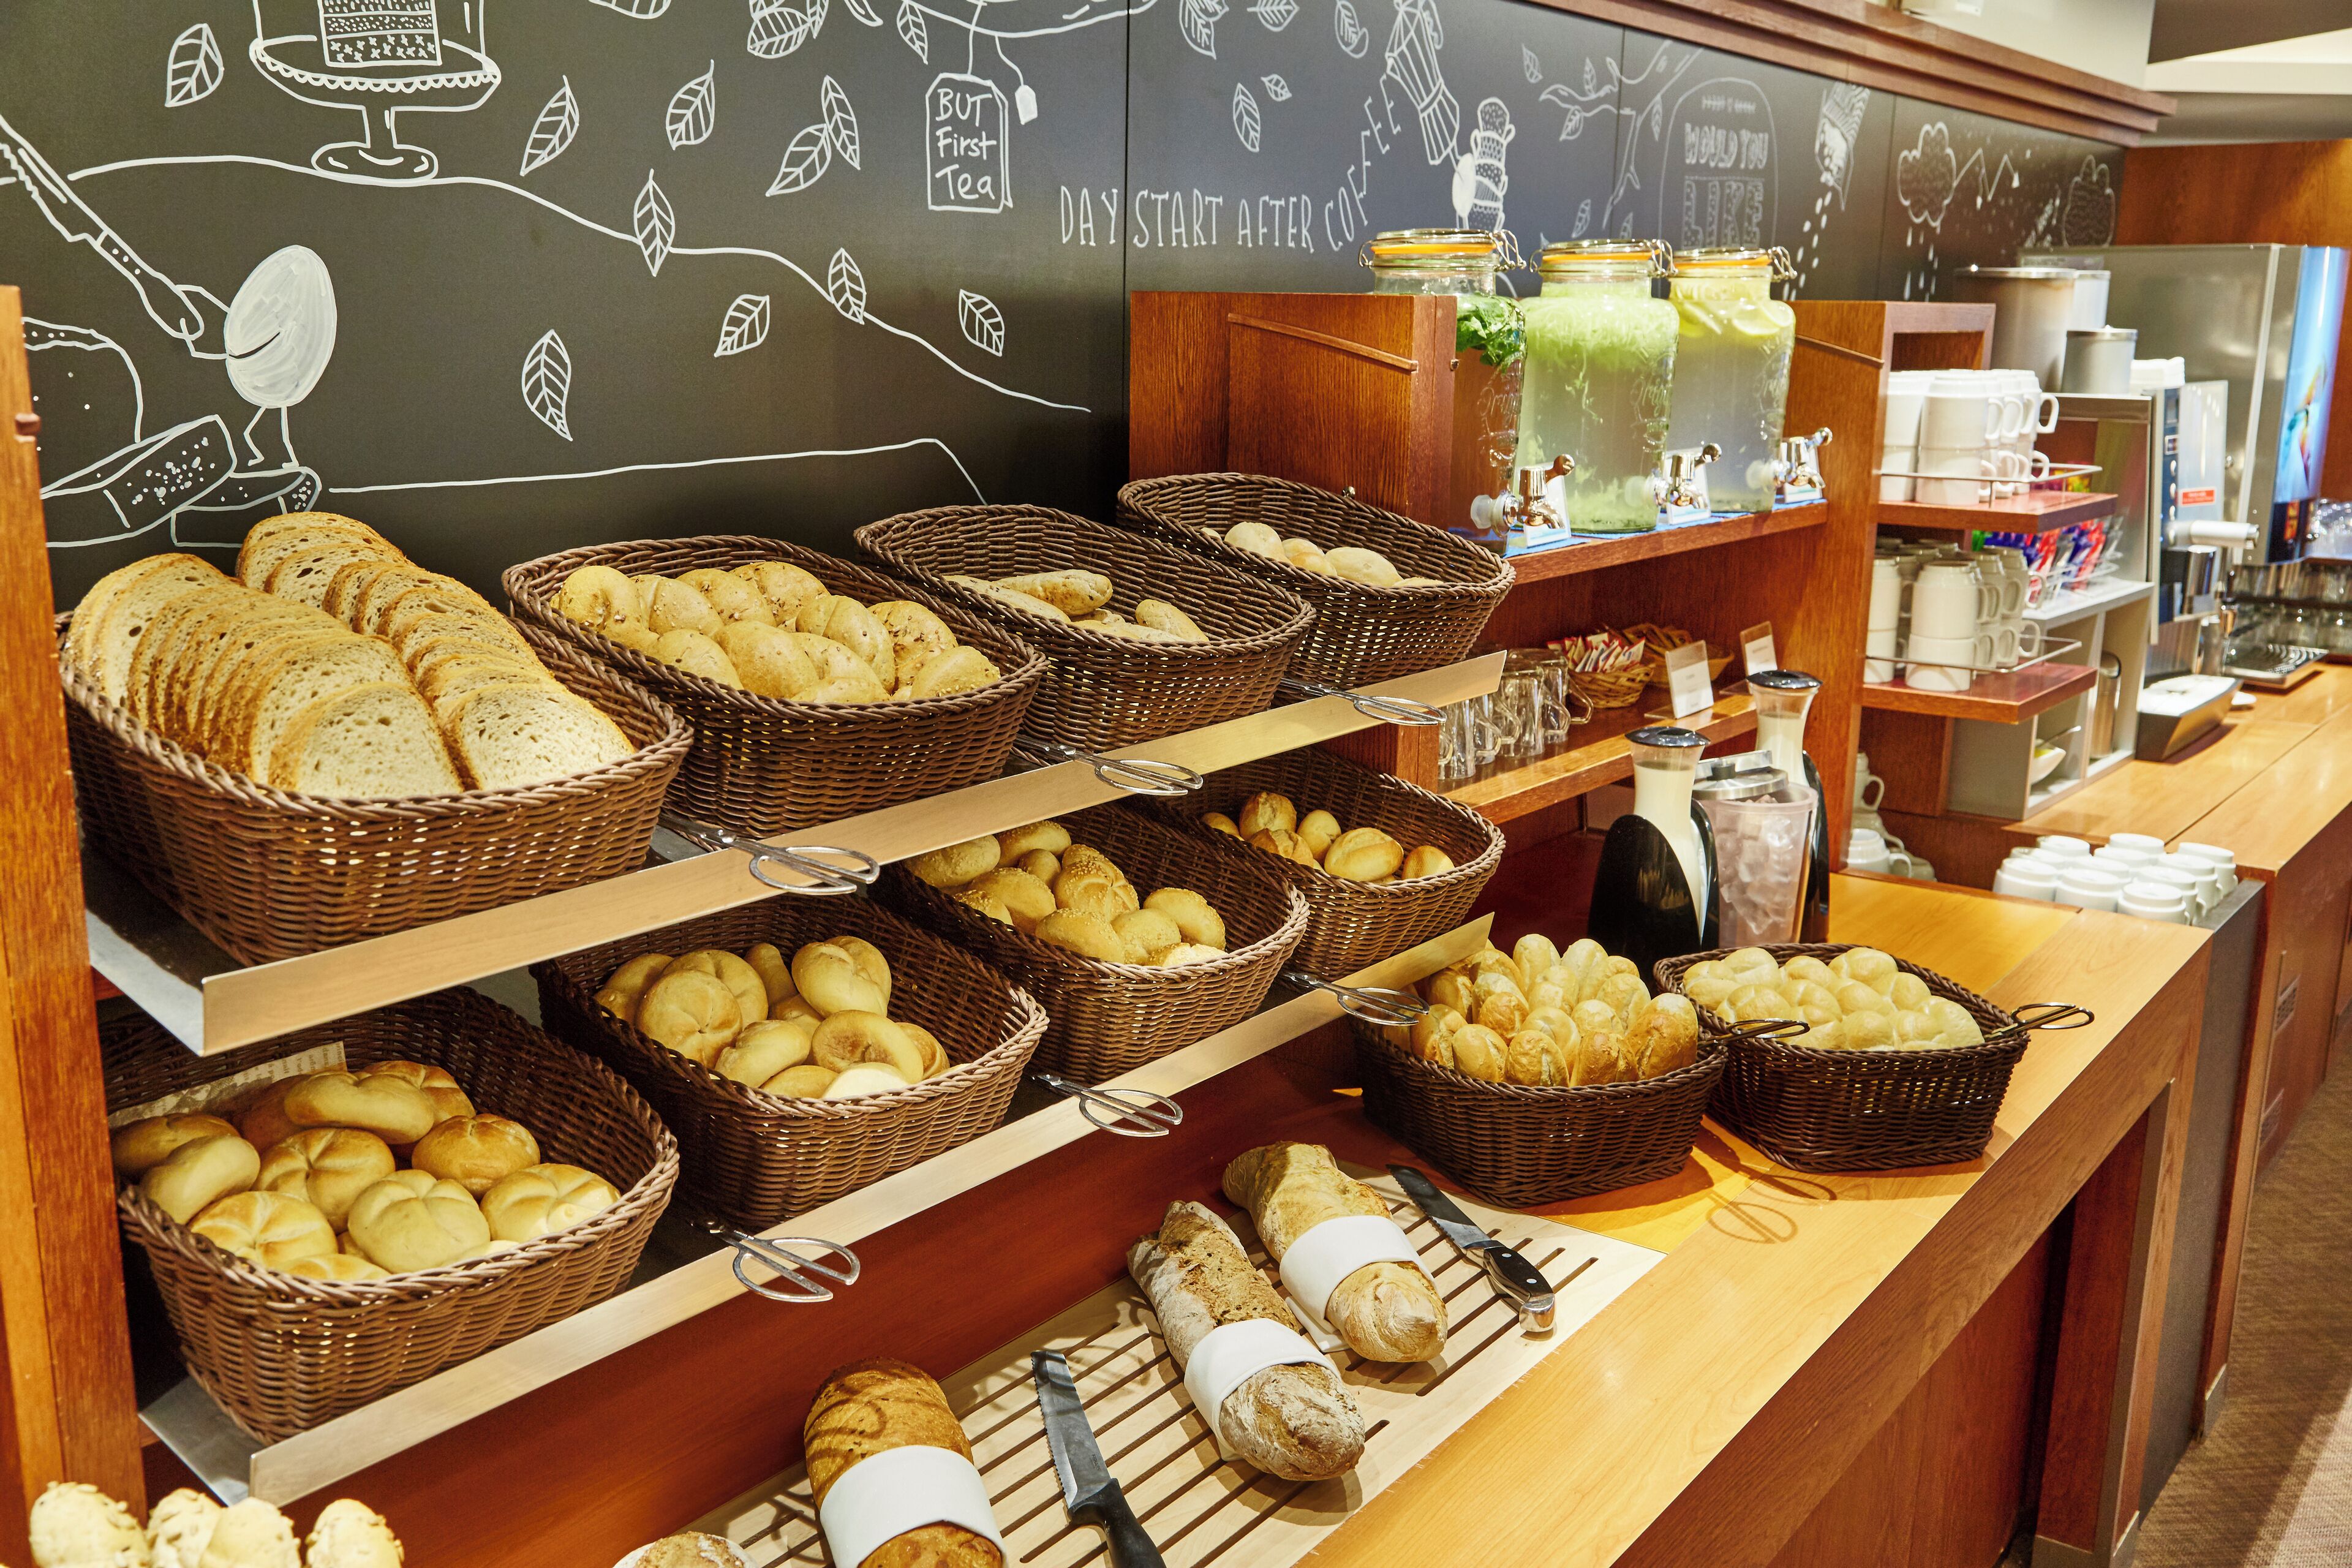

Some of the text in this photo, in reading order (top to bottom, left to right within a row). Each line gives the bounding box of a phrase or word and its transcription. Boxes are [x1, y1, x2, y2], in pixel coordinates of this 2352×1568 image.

[935, 88, 992, 127] BUT
[935, 126, 997, 160] First
[935, 164, 995, 200] Tea
[1061, 72, 1402, 254] DAY START AFTER COFFEE
[1682, 180, 1764, 248] LIKE
